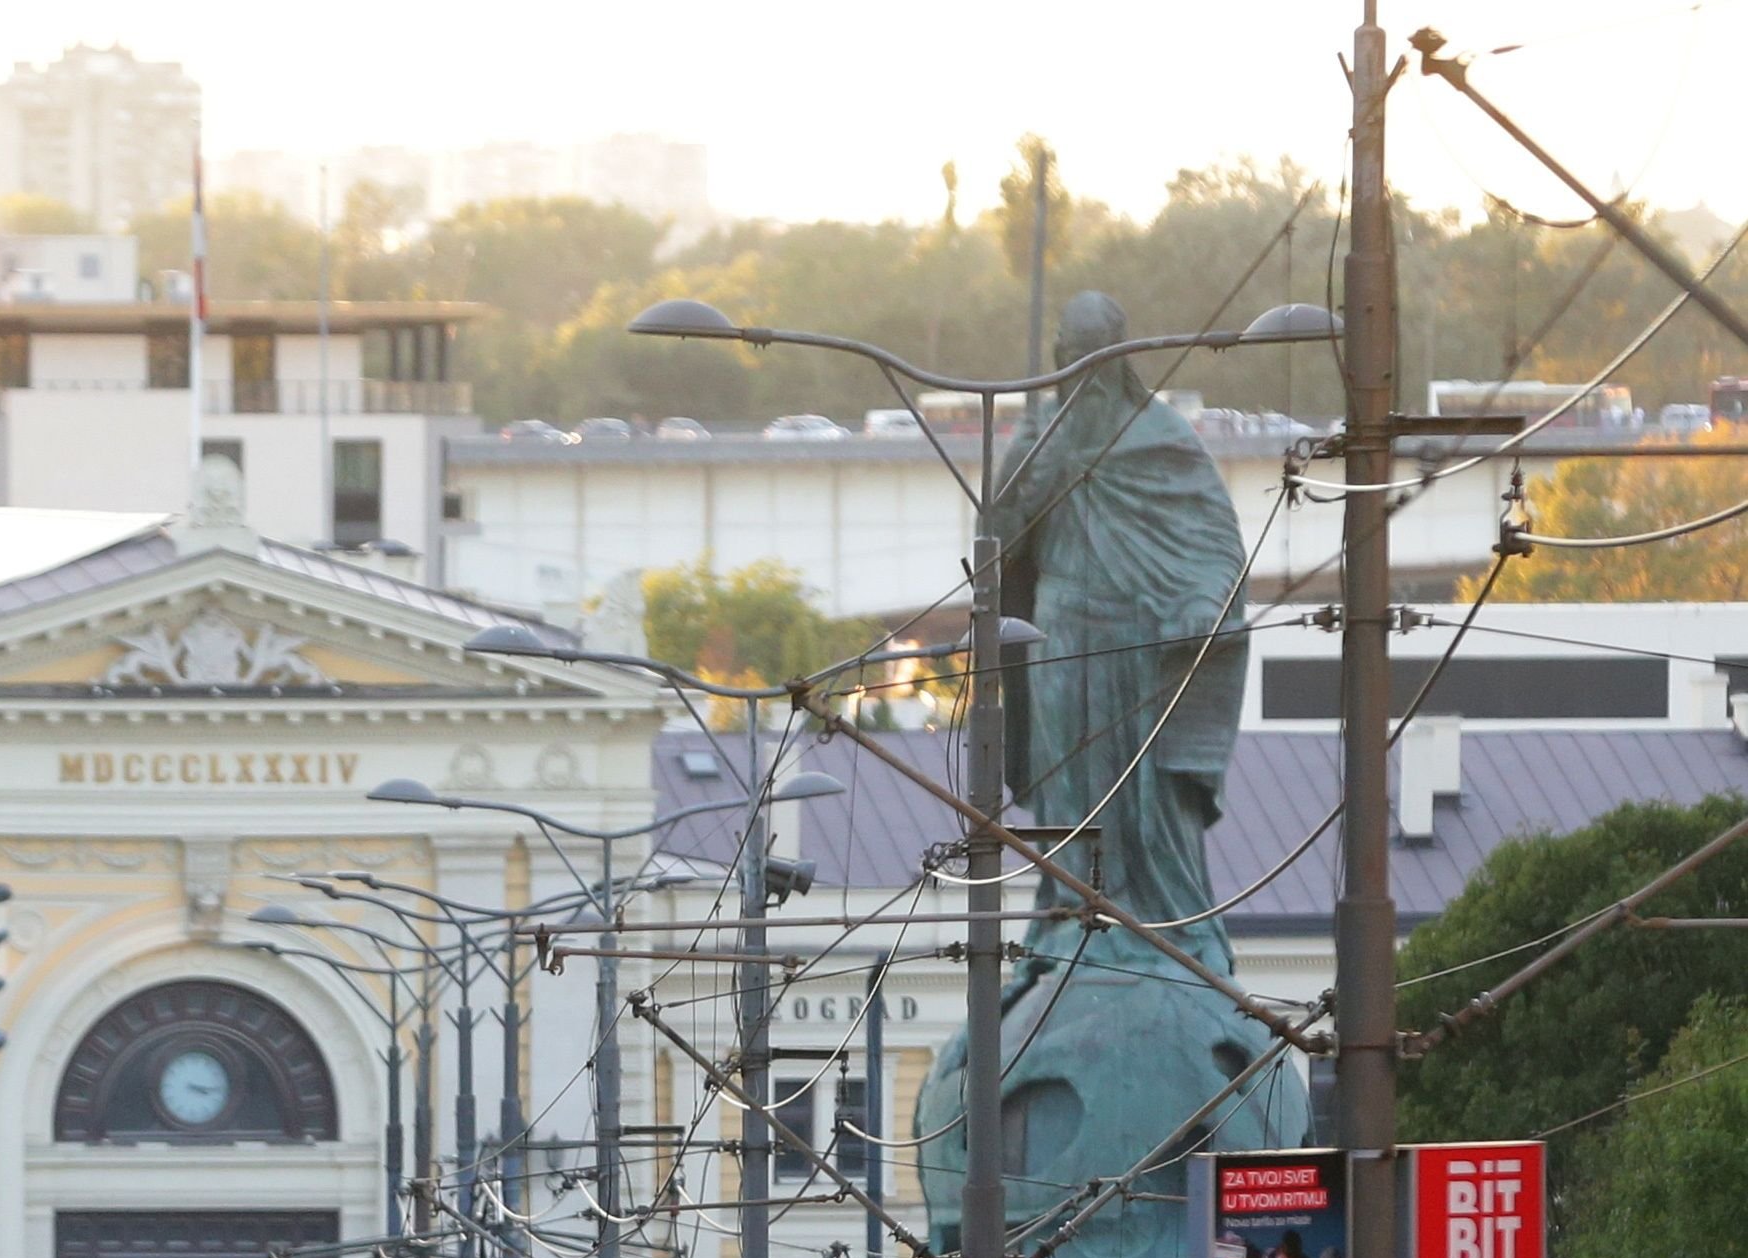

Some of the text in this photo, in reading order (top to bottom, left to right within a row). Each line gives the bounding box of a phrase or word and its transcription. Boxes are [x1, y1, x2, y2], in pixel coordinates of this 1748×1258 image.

[59, 753, 359, 783] MDCCCLXXXIV
[1225, 1168, 1316, 1187] ZA TVOJ SVET
[1226, 1195, 1237, 1209] U
[1239, 1193, 1281, 1208] TVOM
